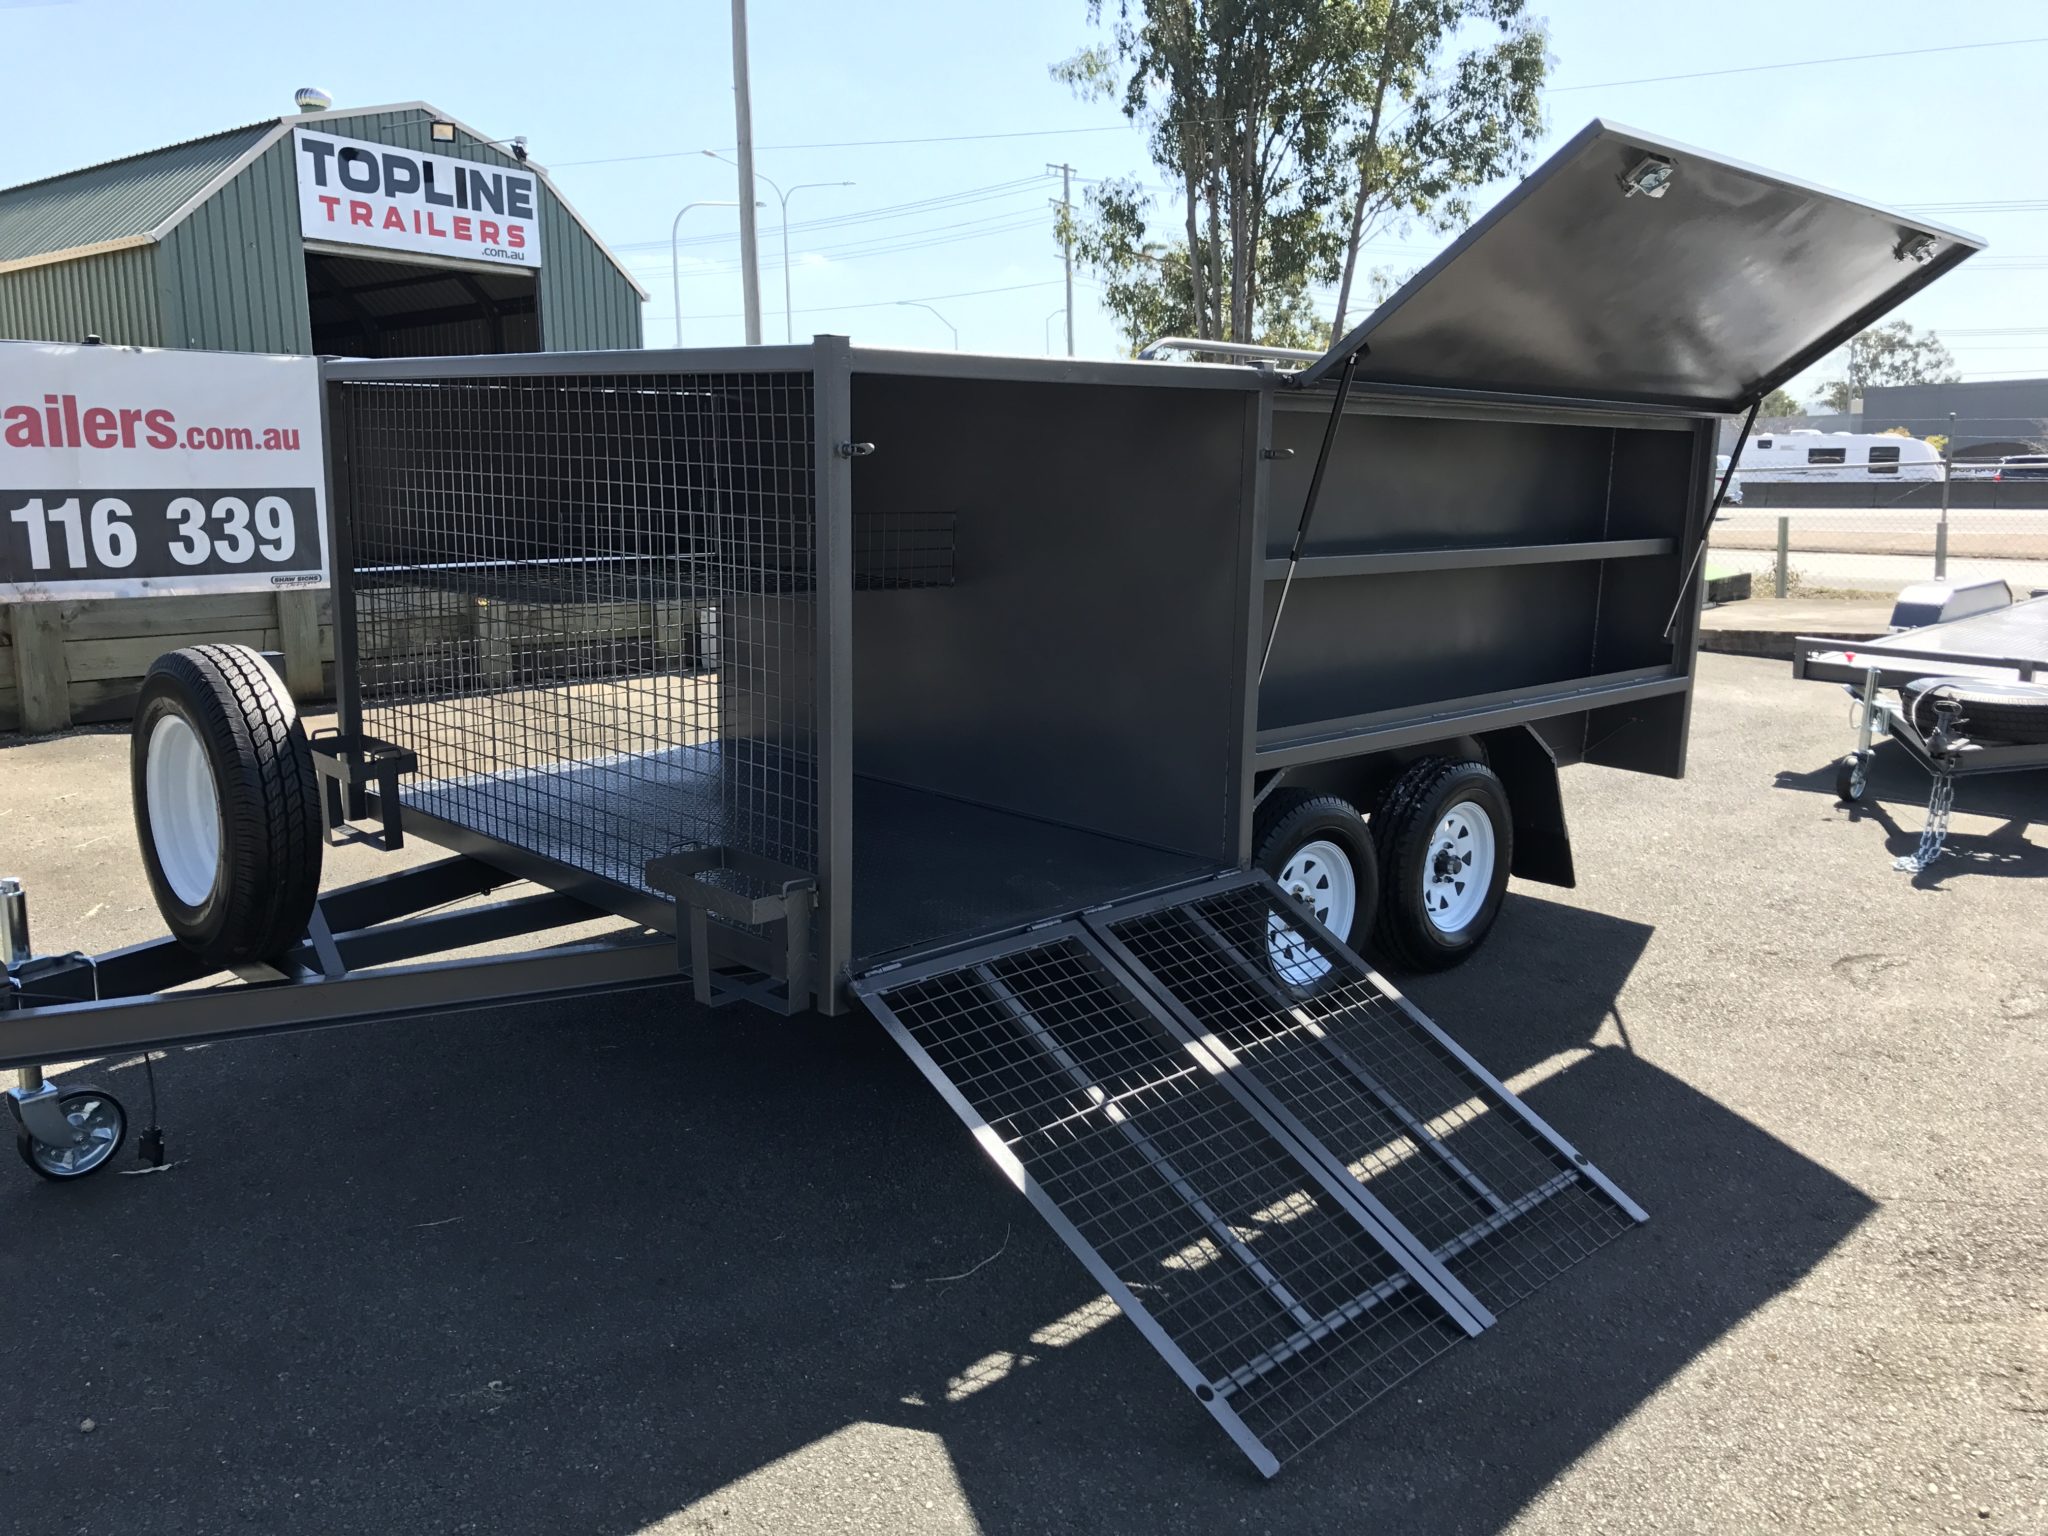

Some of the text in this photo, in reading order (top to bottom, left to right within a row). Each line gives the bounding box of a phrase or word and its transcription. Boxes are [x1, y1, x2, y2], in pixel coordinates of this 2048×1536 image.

[301, 138, 533, 220] TOPLINE
[319, 195, 525, 248] TRAILERS
[482, 248, 525, 261] .com.au
[0, 394, 300, 451] ailers.com.au
[10, 496, 296, 570] 116 339
